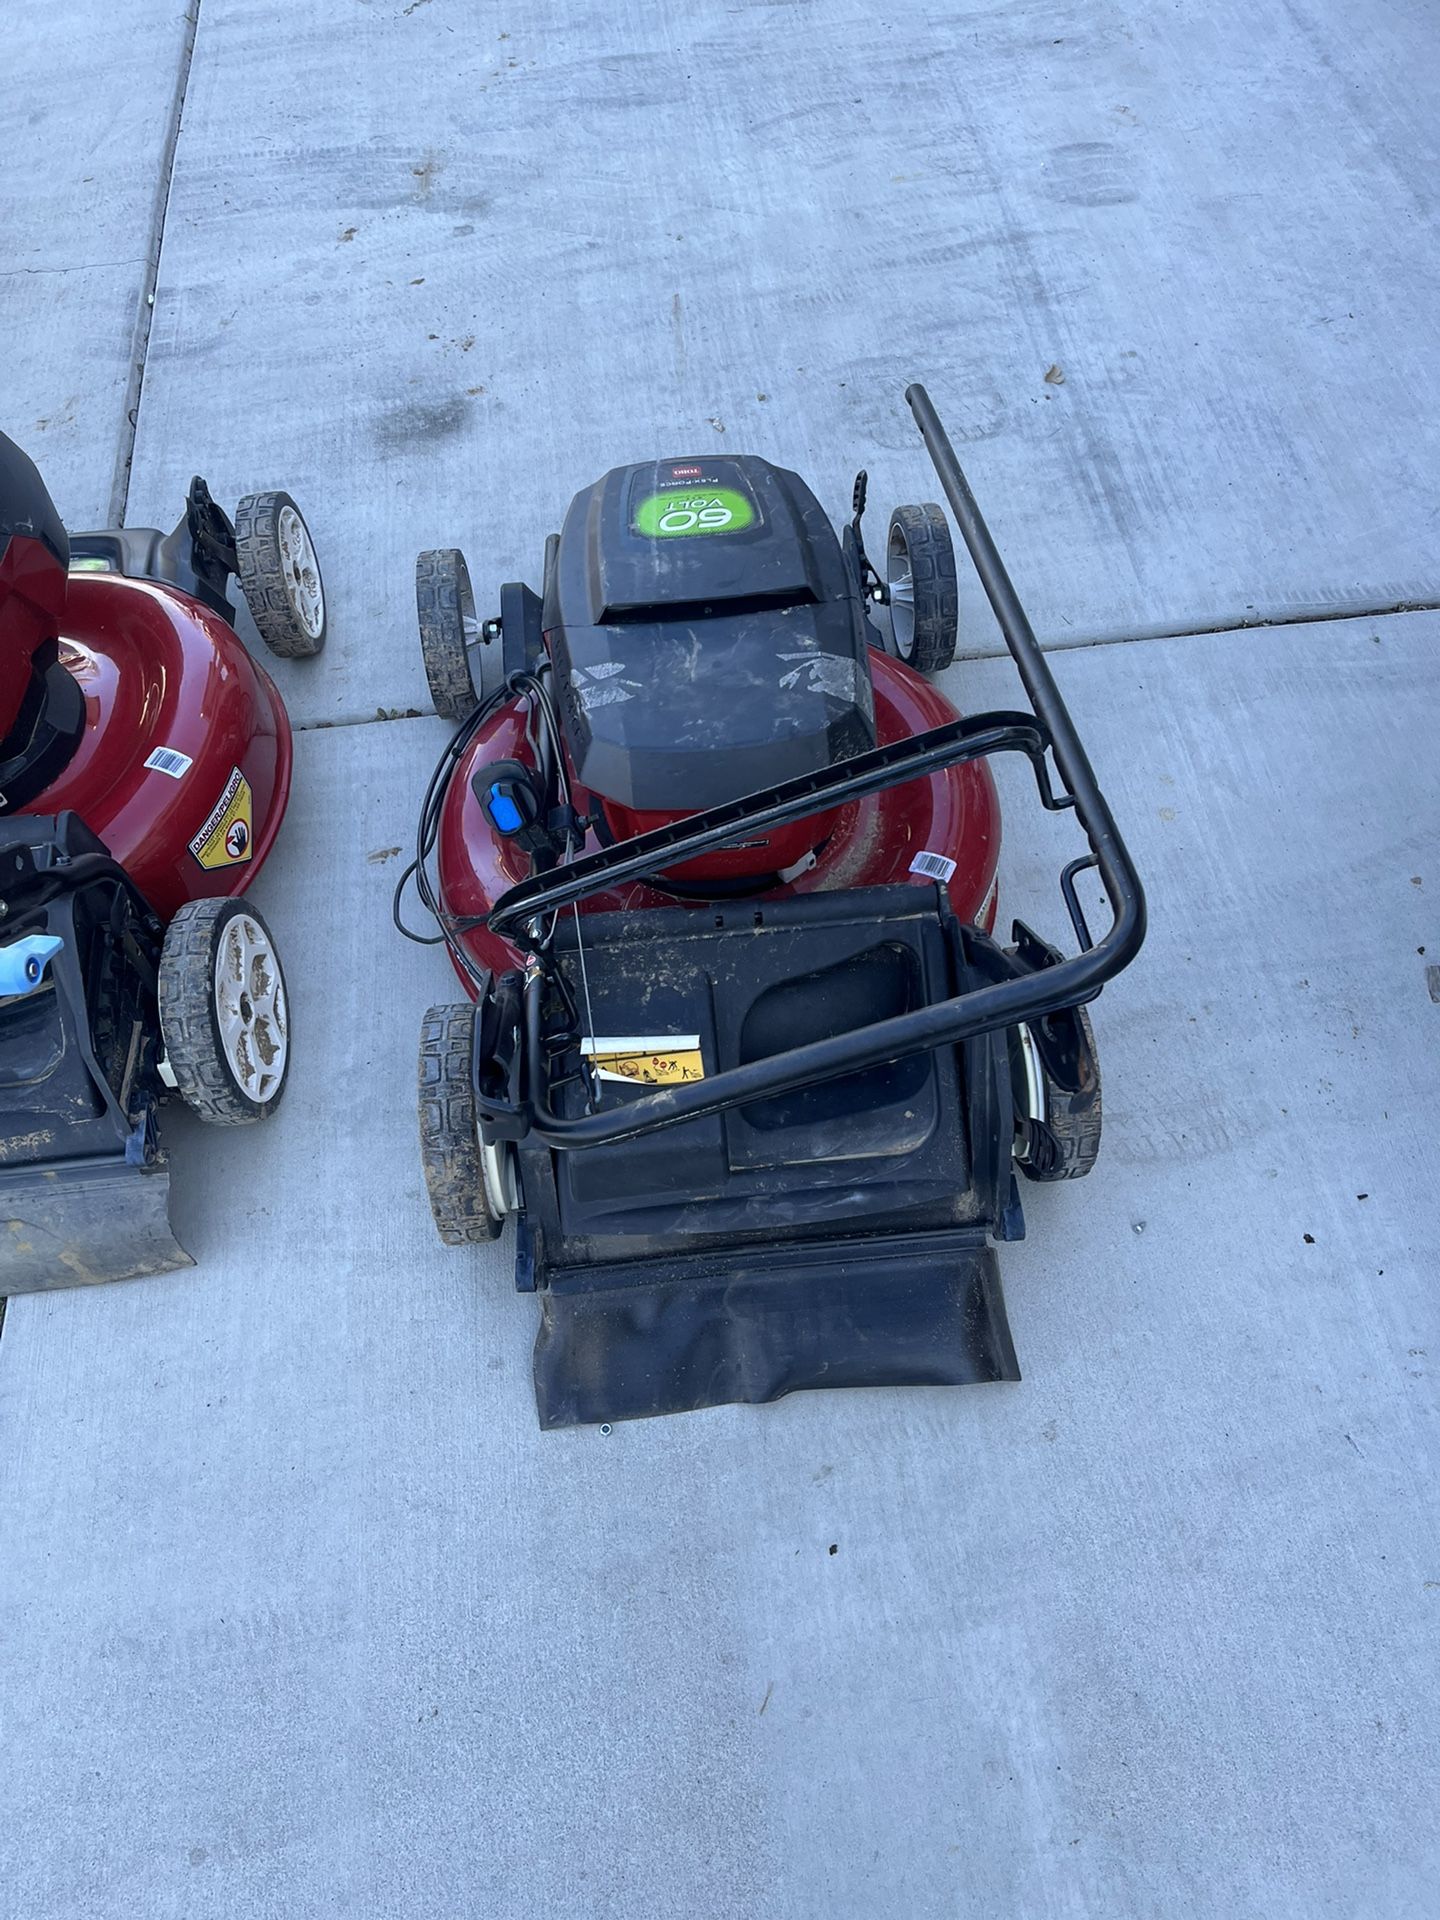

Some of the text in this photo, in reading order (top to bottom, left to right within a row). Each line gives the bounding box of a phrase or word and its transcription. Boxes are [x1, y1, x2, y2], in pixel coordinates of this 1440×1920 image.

[674, 468, 699, 476] TORO
[664, 498, 723, 511] VOLT
[659, 507, 732, 531] 60
